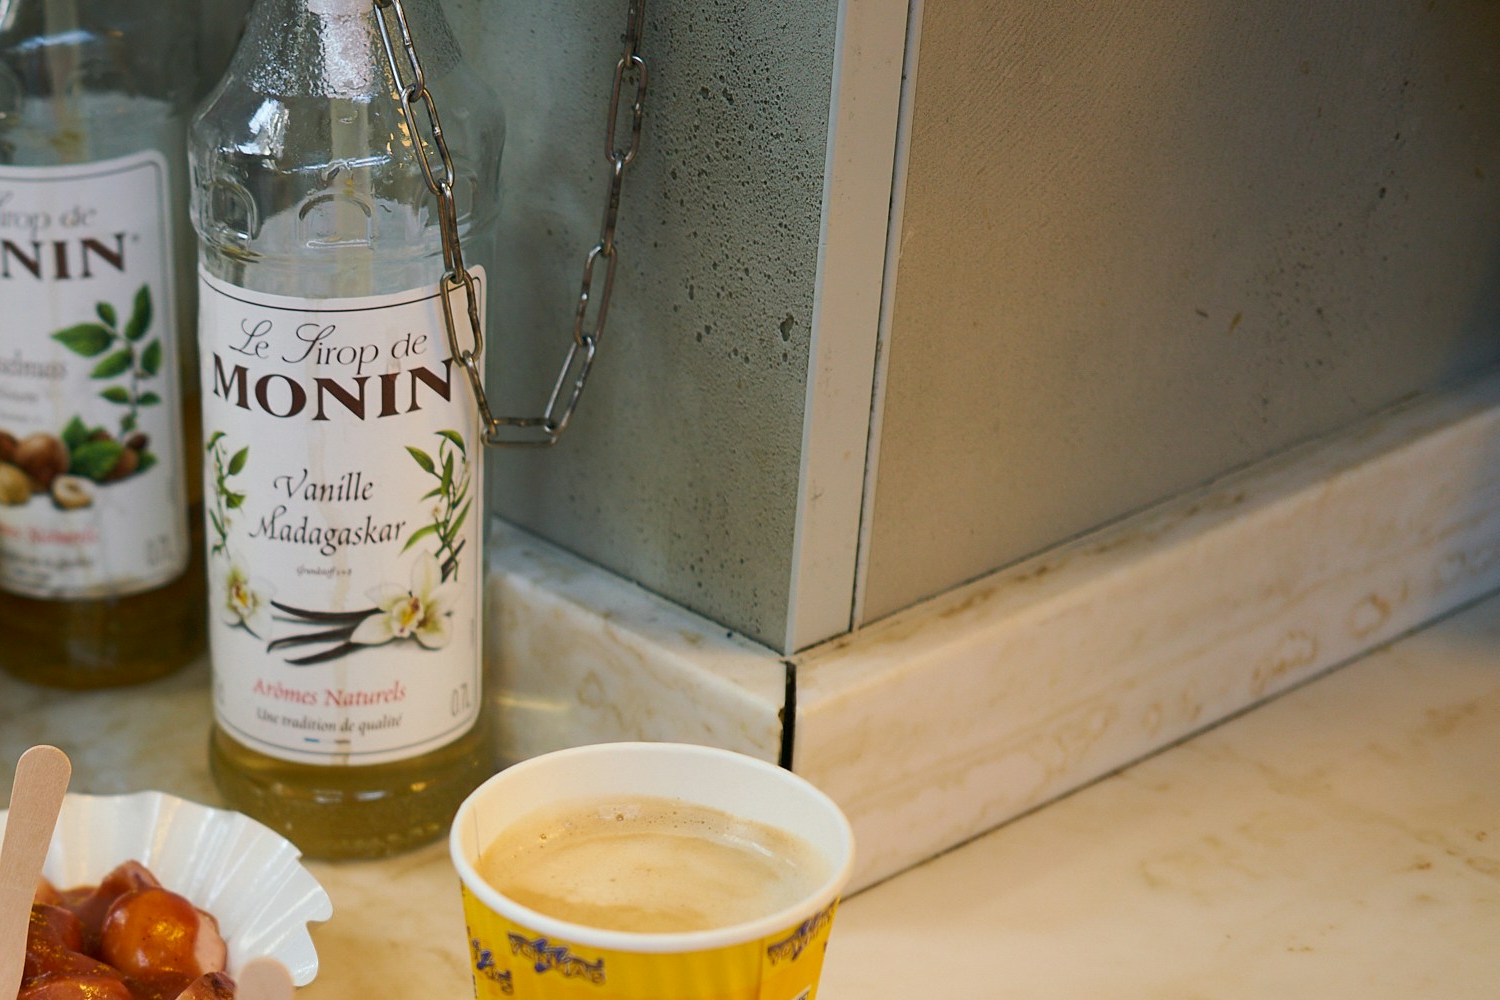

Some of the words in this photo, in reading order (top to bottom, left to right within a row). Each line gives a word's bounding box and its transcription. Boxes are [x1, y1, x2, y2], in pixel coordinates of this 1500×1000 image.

[229, 317, 273, 359] Le
[282, 323, 379, 375] Sirop
[391, 332, 428, 358] de
[212, 352, 455, 421] MONIN
[274, 469, 374, 503] Vanille
[249, 505, 406, 556] Madagaskar
[252, 677, 317, 705] Arômes
[324, 680, 406, 708] Naturels
[282, 710, 336, 733] tradition
[339, 714, 355, 732] de
[358, 714, 403, 736] qualité
